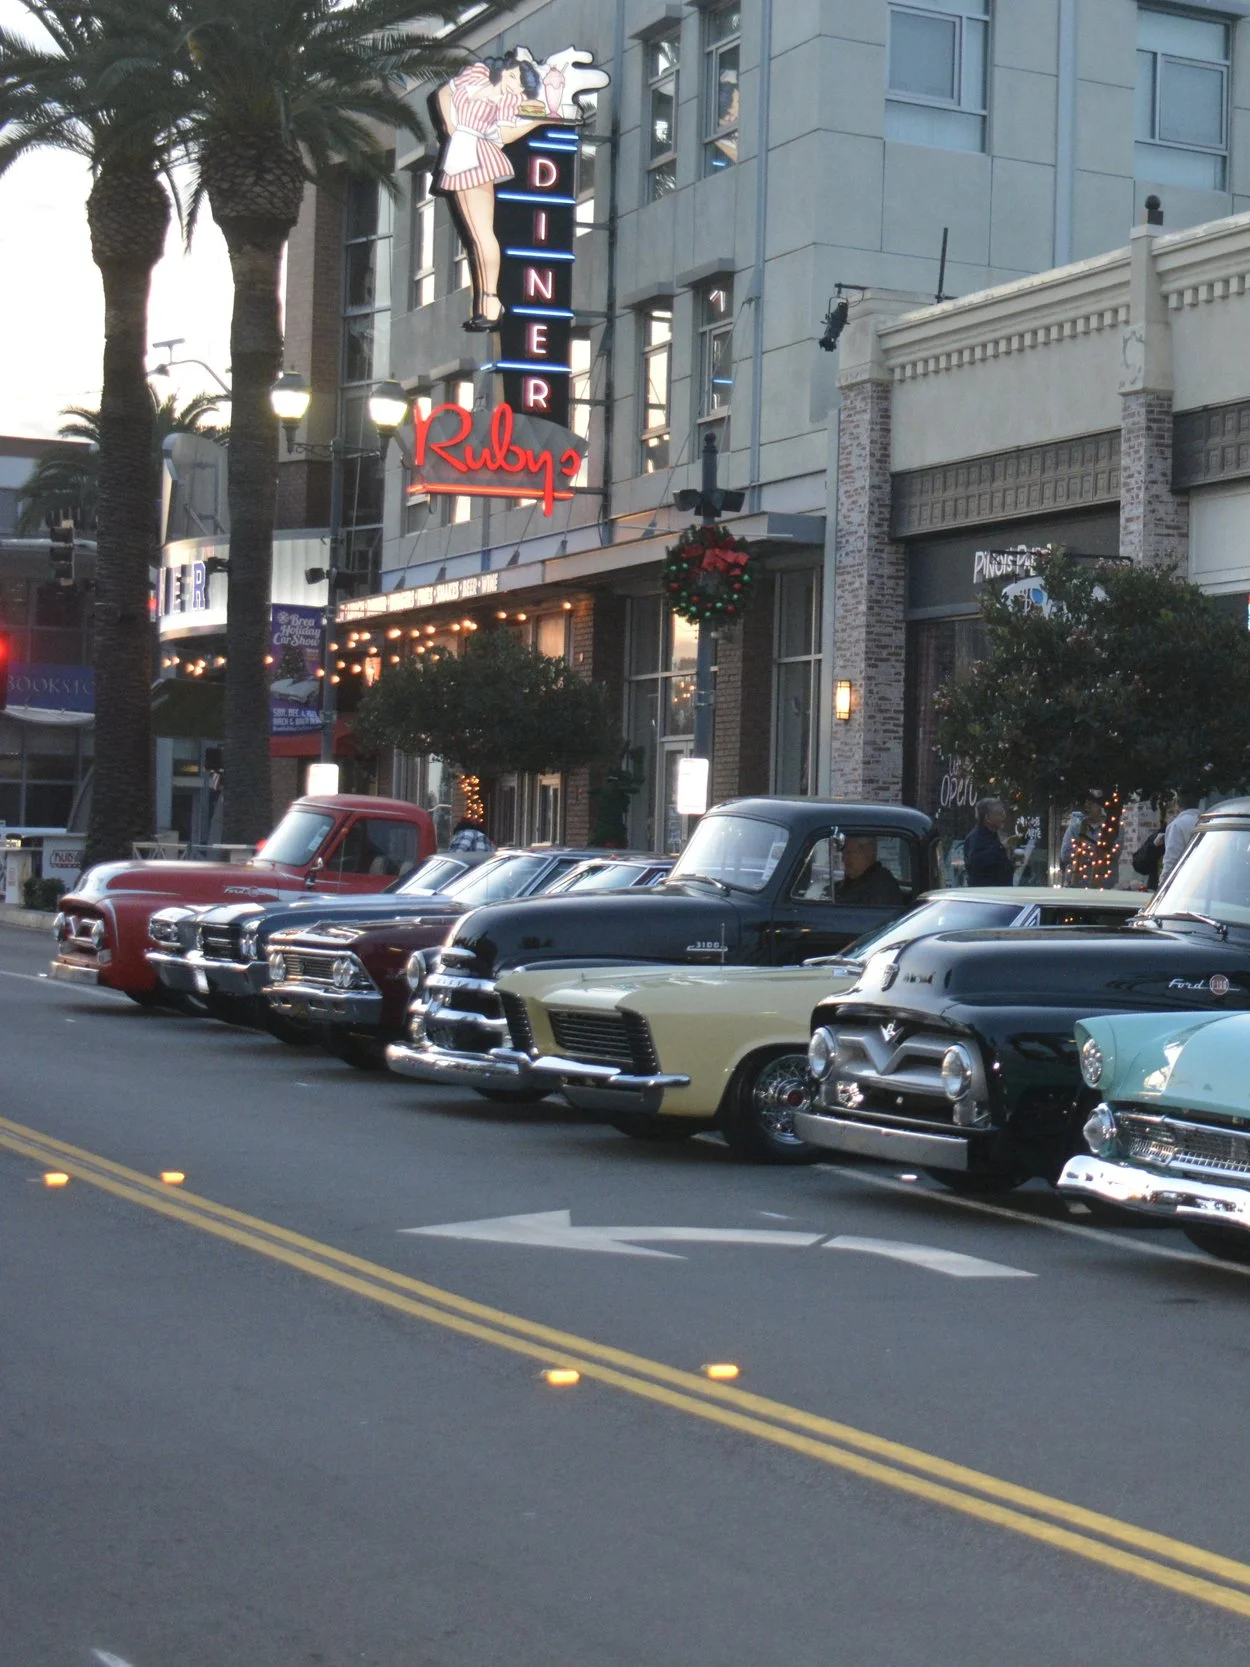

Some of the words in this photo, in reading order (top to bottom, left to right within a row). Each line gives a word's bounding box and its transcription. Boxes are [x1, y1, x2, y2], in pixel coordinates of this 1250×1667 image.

[528, 158, 558, 409] DINER
[290, 613, 315, 626] Brea
[280, 624, 321, 640] Holiday
[1168, 978, 1205, 990] Ford
